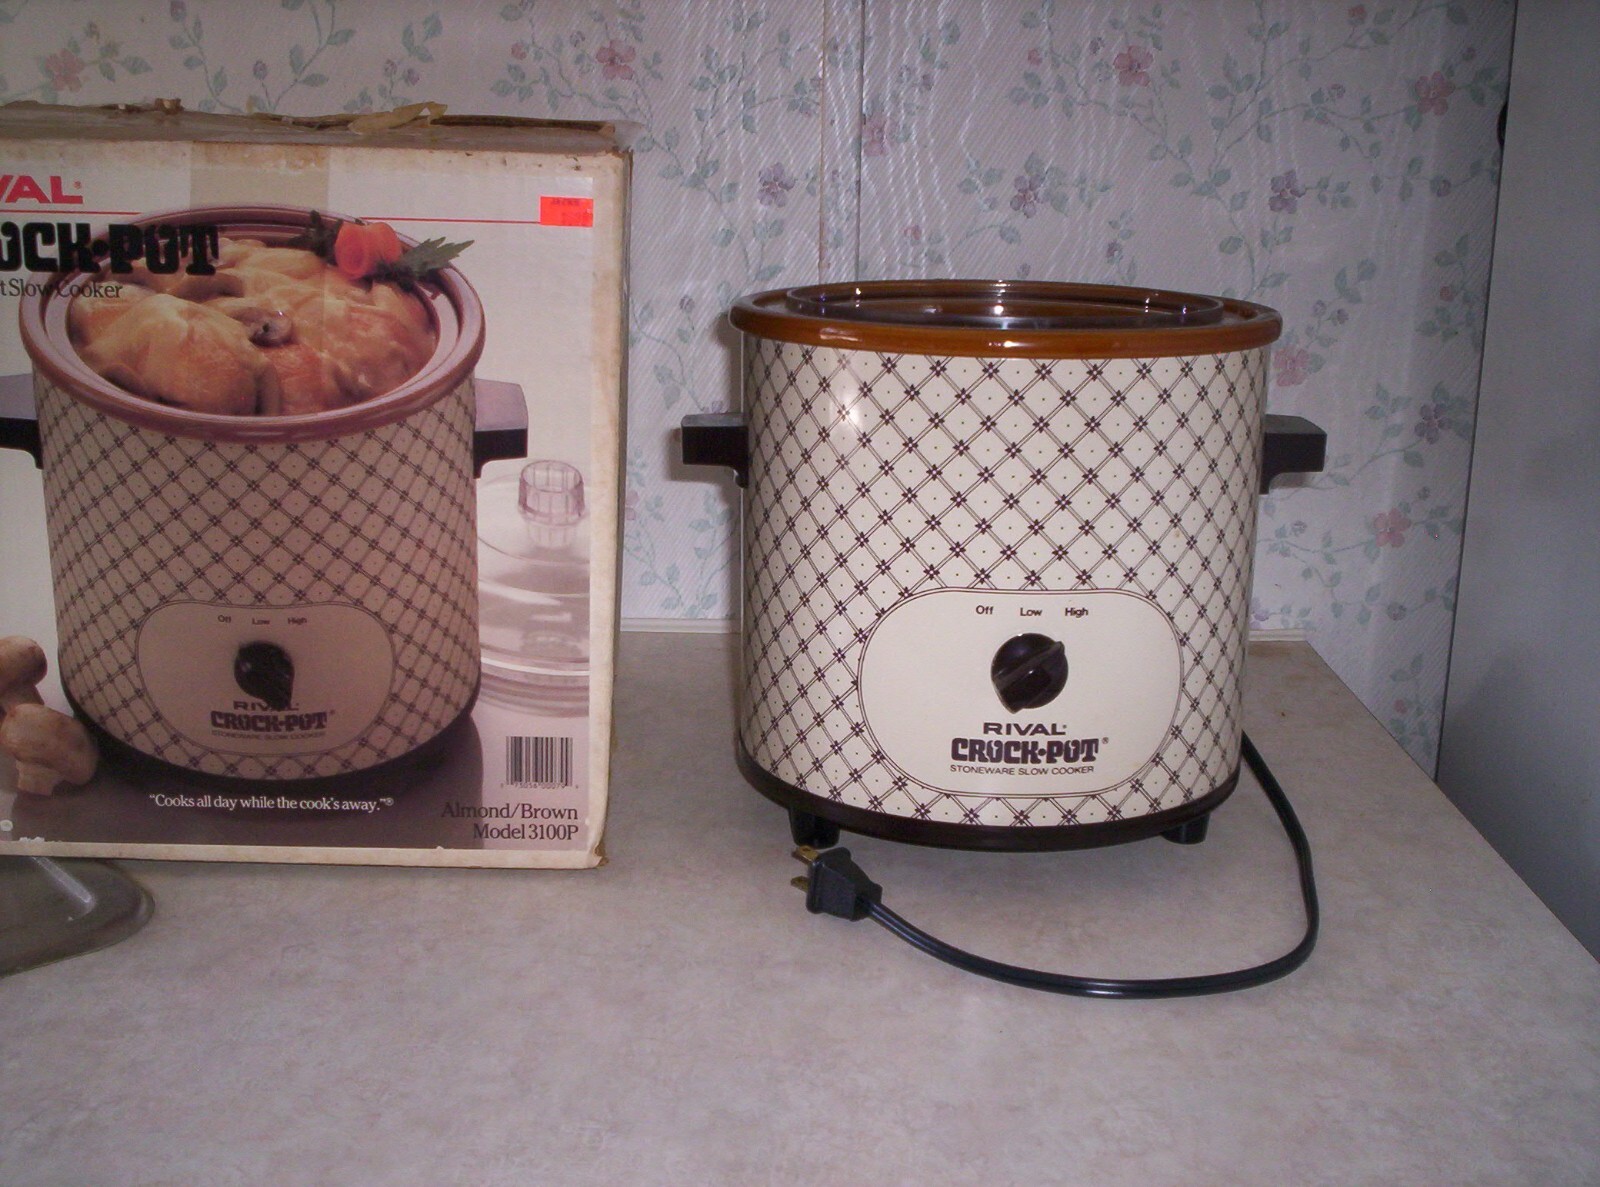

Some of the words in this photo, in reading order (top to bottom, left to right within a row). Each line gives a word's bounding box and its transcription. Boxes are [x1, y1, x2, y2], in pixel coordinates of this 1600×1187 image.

[9, 278, 52, 297] Slow
[56, 279, 123, 298] Cooker
[975, 605, 994, 615] Off
[1020, 607, 1043, 617] Low
[1065, 607, 1089, 618] High
[983, 722, 1067, 736] RIVAL
[950, 764, 1015, 775] STONEWARE
[1018, 768, 1048, 776] SLOW
[1051, 765, 1095, 775] COOKER
[196, 795, 212, 808] all
[213, 796, 237, 811] day
[239, 796, 275, 809] while
[276, 796, 298, 809] the
[441, 802, 579, 820] Almond/Brown
[473, 823, 526, 840] Model
[528, 824, 579, 840] 3100P
